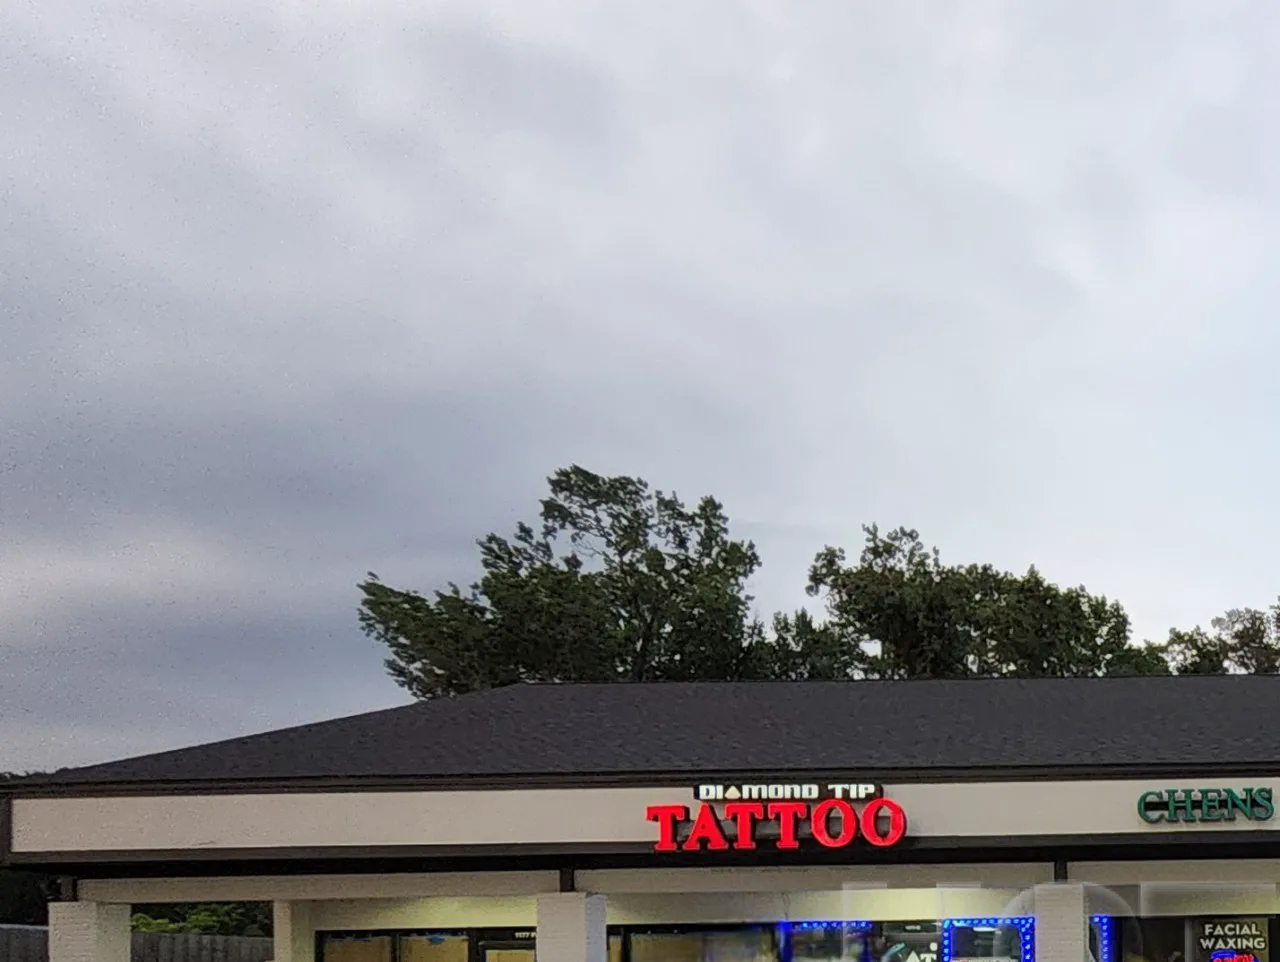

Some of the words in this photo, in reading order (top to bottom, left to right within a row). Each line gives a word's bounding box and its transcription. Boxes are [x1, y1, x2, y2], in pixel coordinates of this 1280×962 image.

[699, 784, 819, 800] DIAMOND
[828, 783, 875, 798] TIP
[1138, 787, 1274, 824] CHENS
[646, 798, 907, 850] TATTOO
[1204, 923, 1261, 936] FACIAL
[1200, 937, 1266, 950] WAXING
